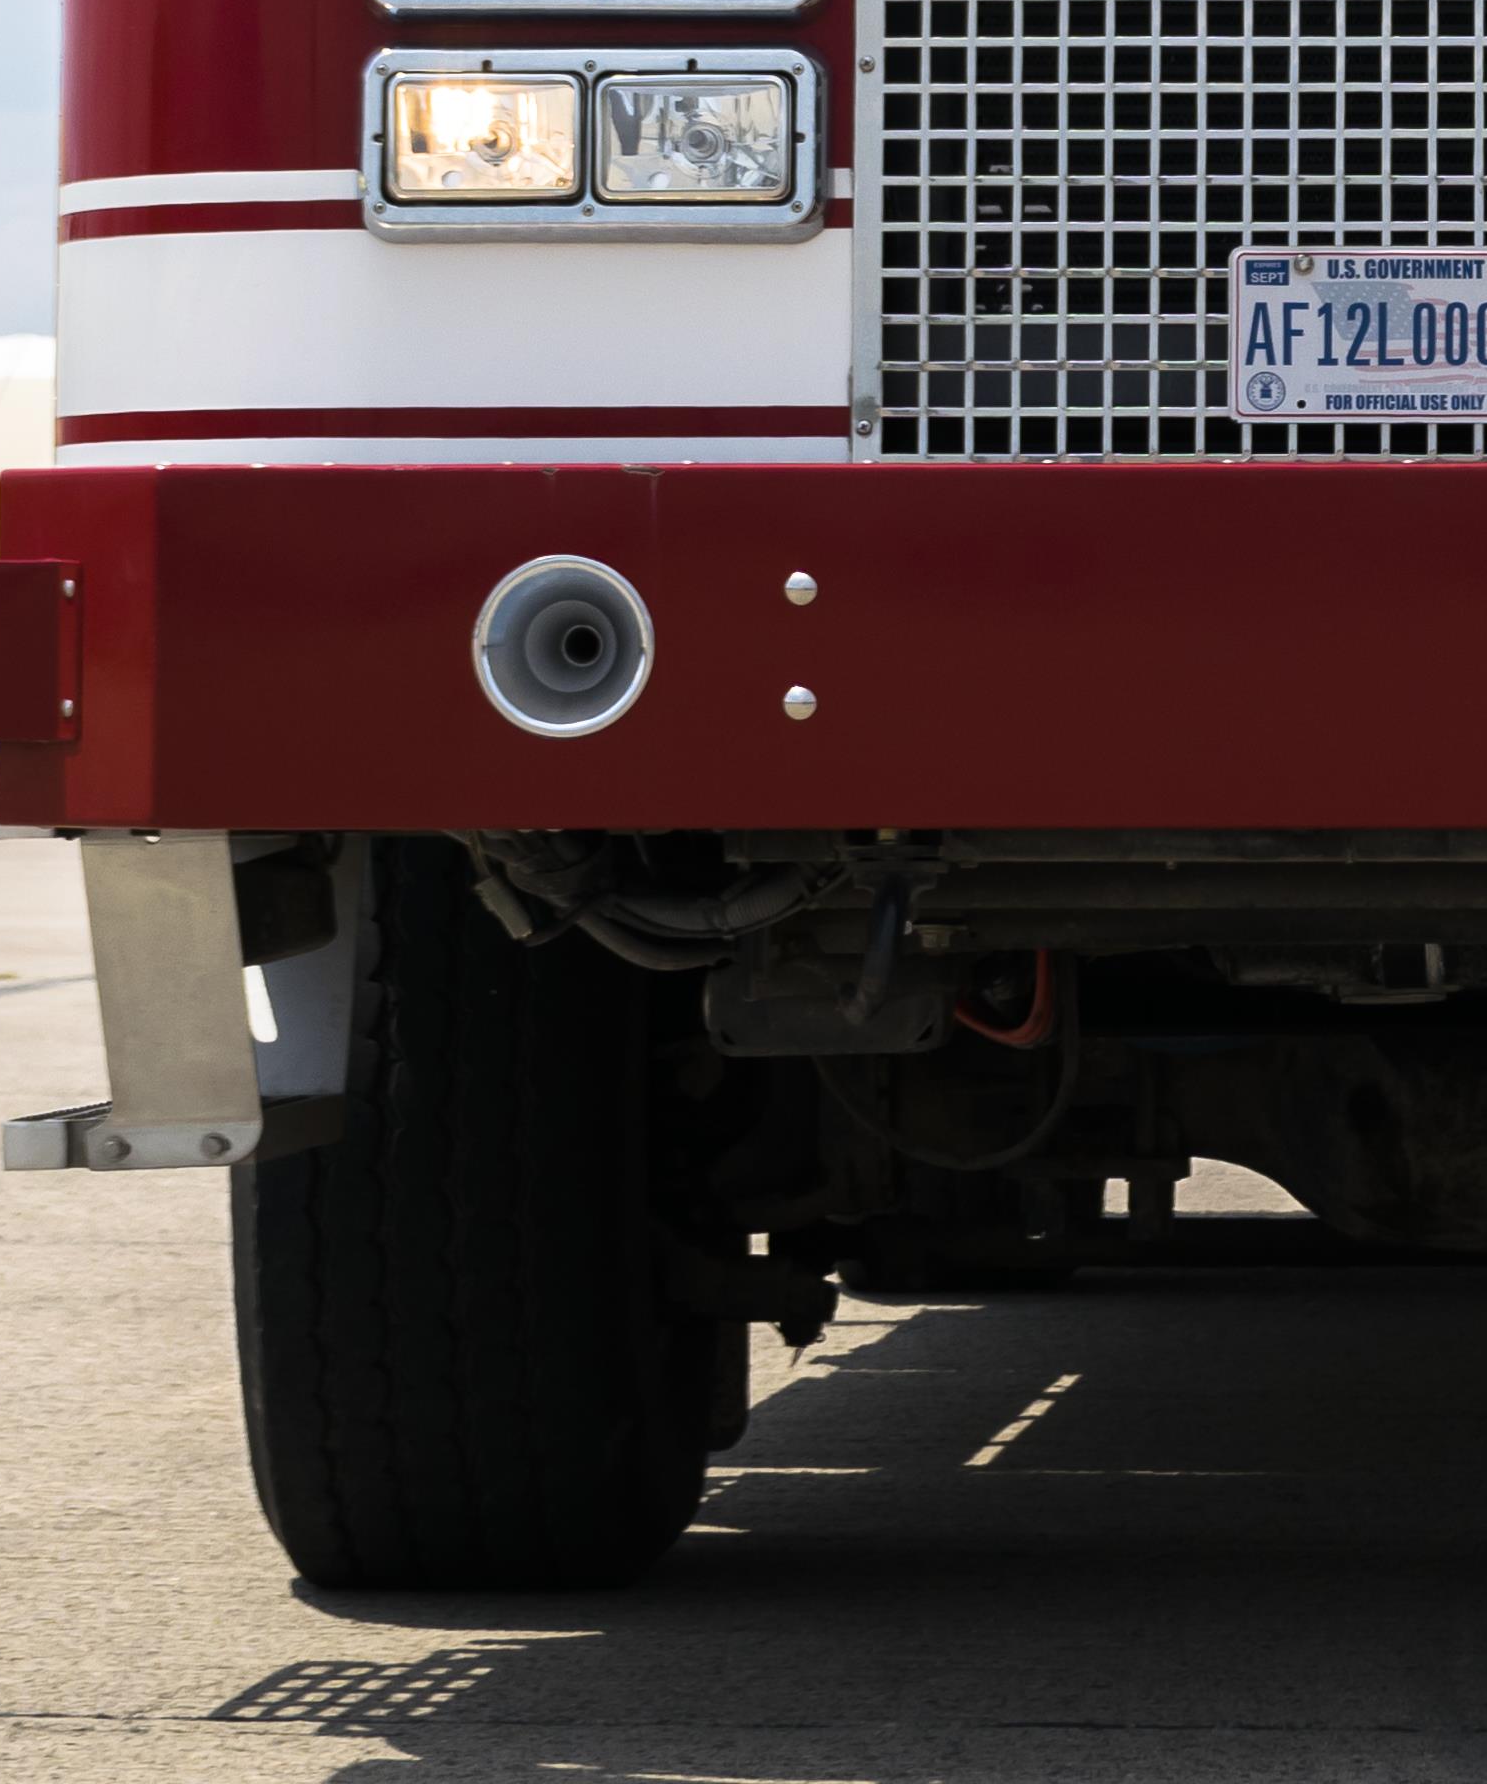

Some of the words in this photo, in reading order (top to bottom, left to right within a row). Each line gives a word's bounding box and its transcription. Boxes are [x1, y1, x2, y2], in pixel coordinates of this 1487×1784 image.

[1327, 258, 1360, 279] U.S.
[1364, 258, 1485, 279] GOVERNMENT
[1250, 271, 1286, 284] SEPT
[1325, 394, 1353, 410] FOR
[1355, 394, 1417, 410] OFFICIAL
[1420, 394, 1447, 410] USE
[1451, 394, 1486, 410] ONLY
